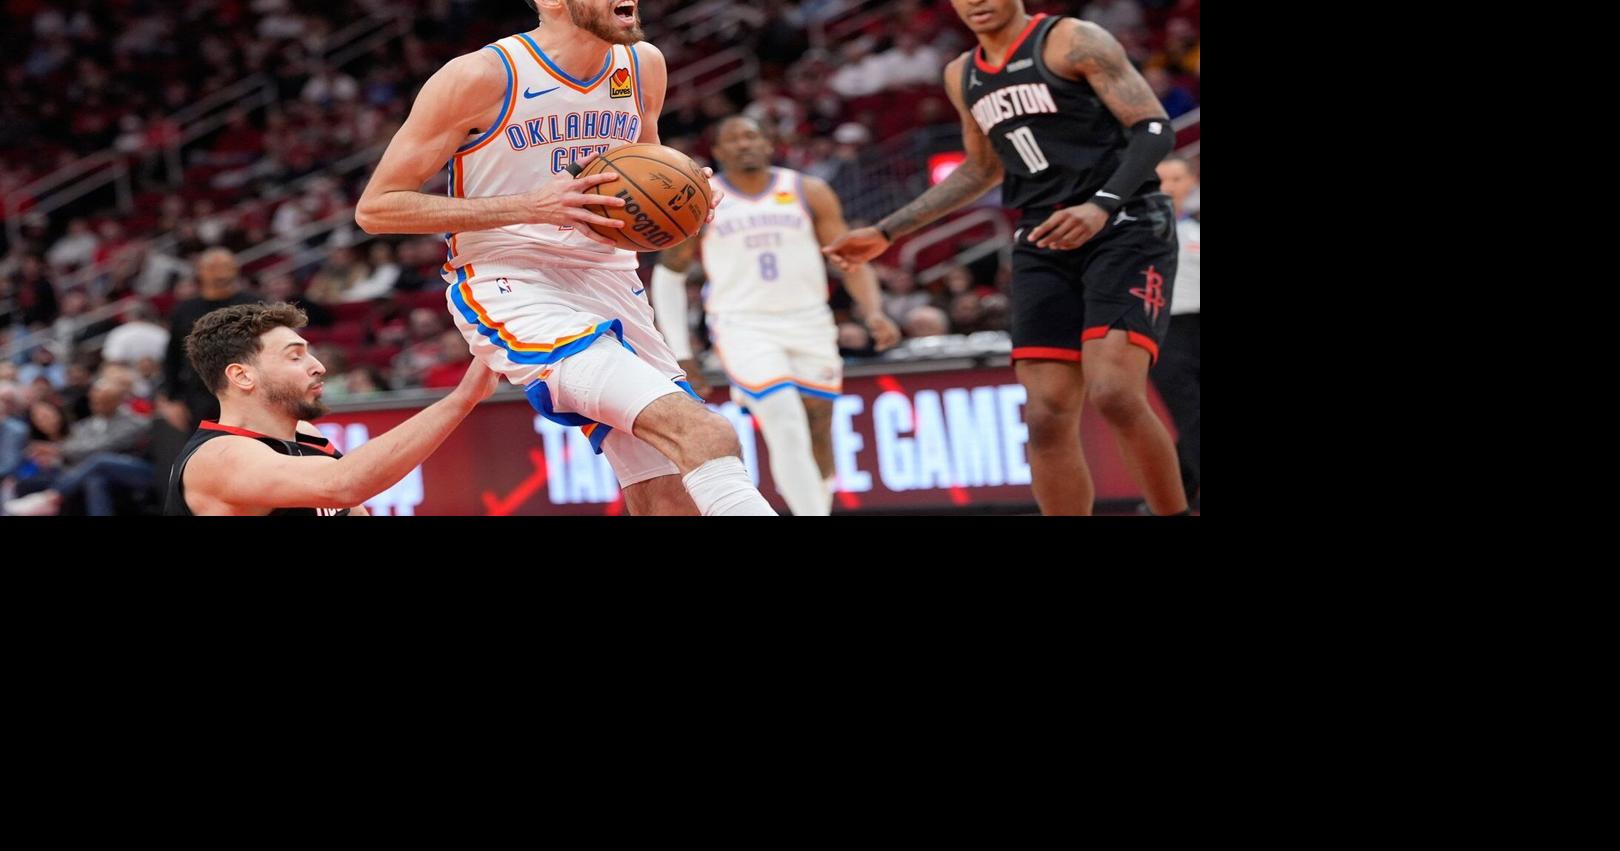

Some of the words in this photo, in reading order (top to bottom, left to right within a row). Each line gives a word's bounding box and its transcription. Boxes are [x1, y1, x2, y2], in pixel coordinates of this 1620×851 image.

[505, 111, 640, 151] OKLAHOMA
[1004, 126, 1049, 173] 10
[615, 189, 674, 247] Wilson
[758, 251, 779, 282] 8
[873, 384, 1032, 491] GAME
